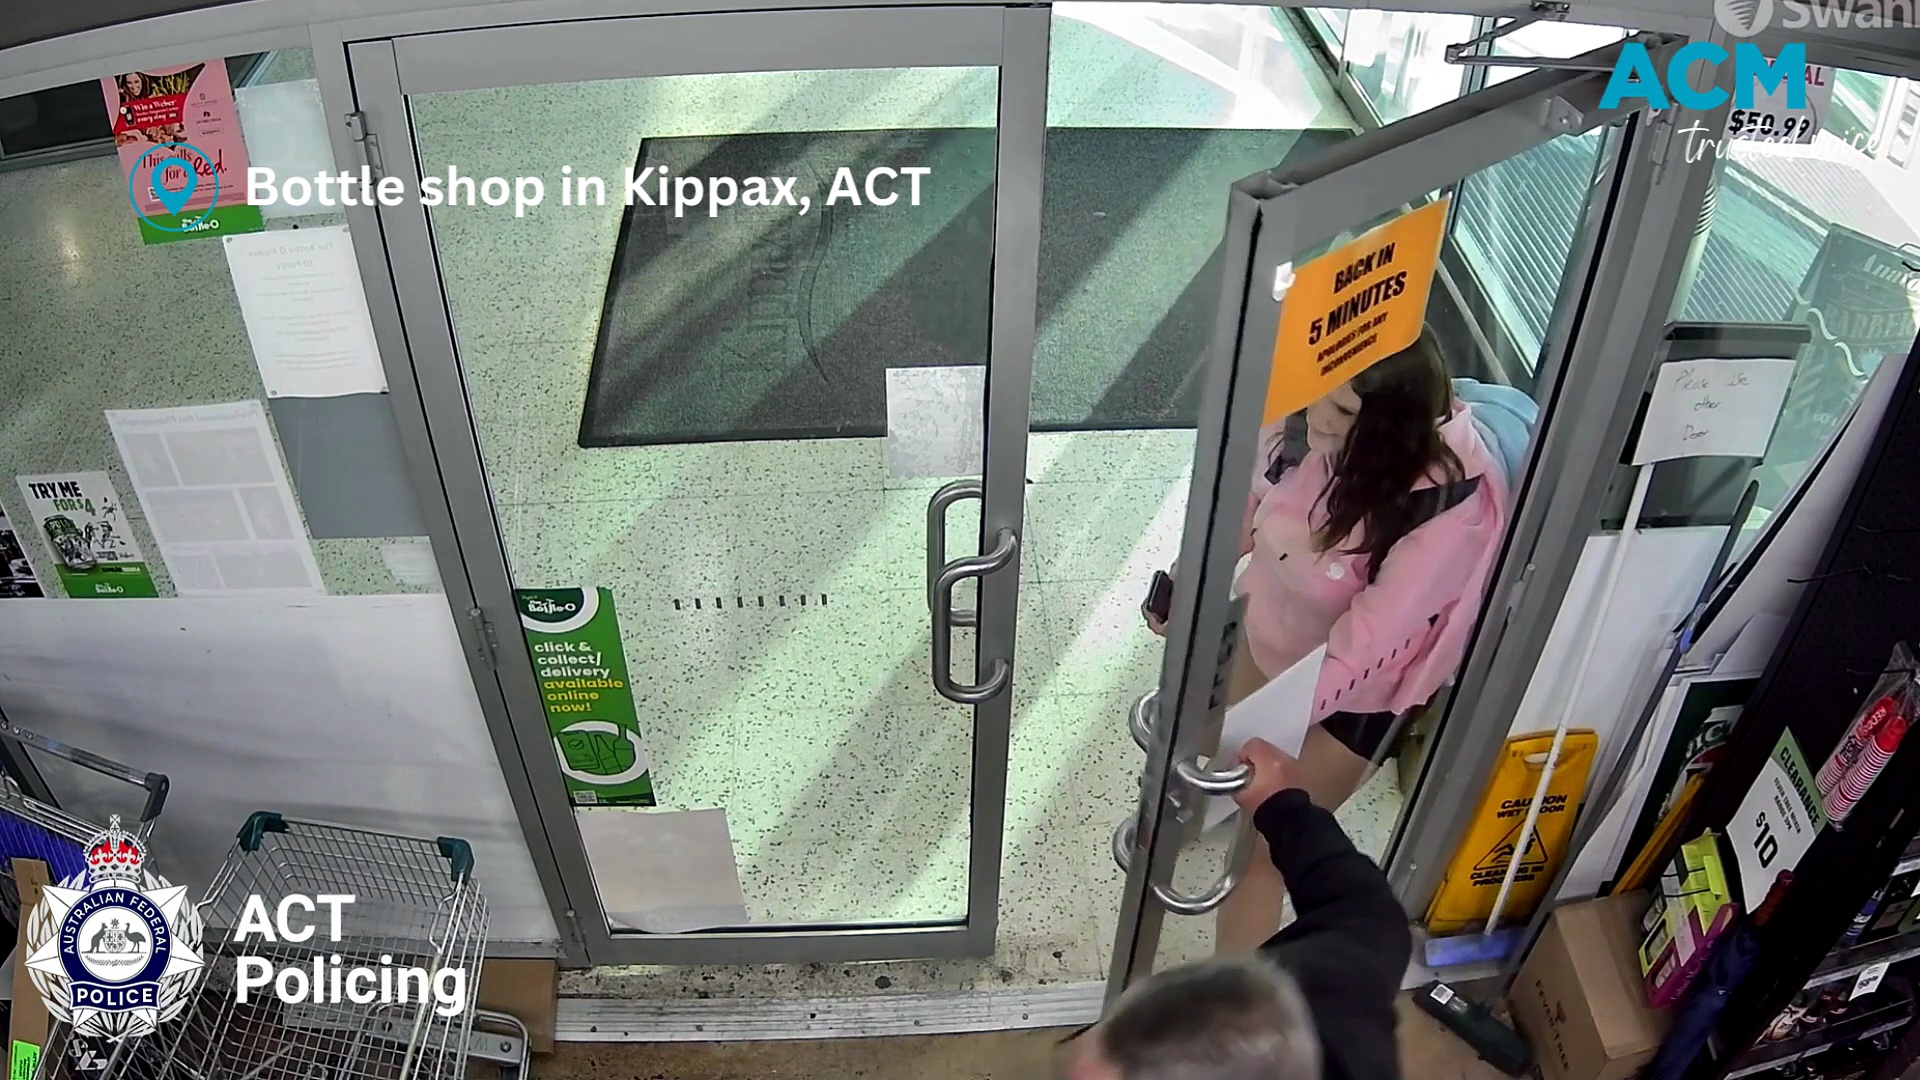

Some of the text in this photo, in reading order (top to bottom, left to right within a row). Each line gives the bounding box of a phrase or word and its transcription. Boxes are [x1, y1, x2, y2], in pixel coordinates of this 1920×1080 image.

[1333, 242, 1396, 294] BACK IN
[1308, 271, 1407, 345] 5 MINUTES
[1357, 320, 1373, 337] FOR
[1371, 311, 1389, 329] ANY
[28, 481, 83, 499] TRY ME
[53, 498, 78, 512] FOR
[534, 641, 593, 653] click &
[537, 652, 602, 666] collect/
[540, 666, 611, 679] delivery
[544, 678, 624, 689] available
[547, 690, 600, 700] online
[550, 702, 592, 713] now!
[1780, 746, 1820, 828] CLEARANCE
[1500, 794, 1568, 810] CAUION
[1497, 808, 1523, 819] WET
[1753, 811, 1779, 869] $10
[1531, 865, 1545, 873] IN
